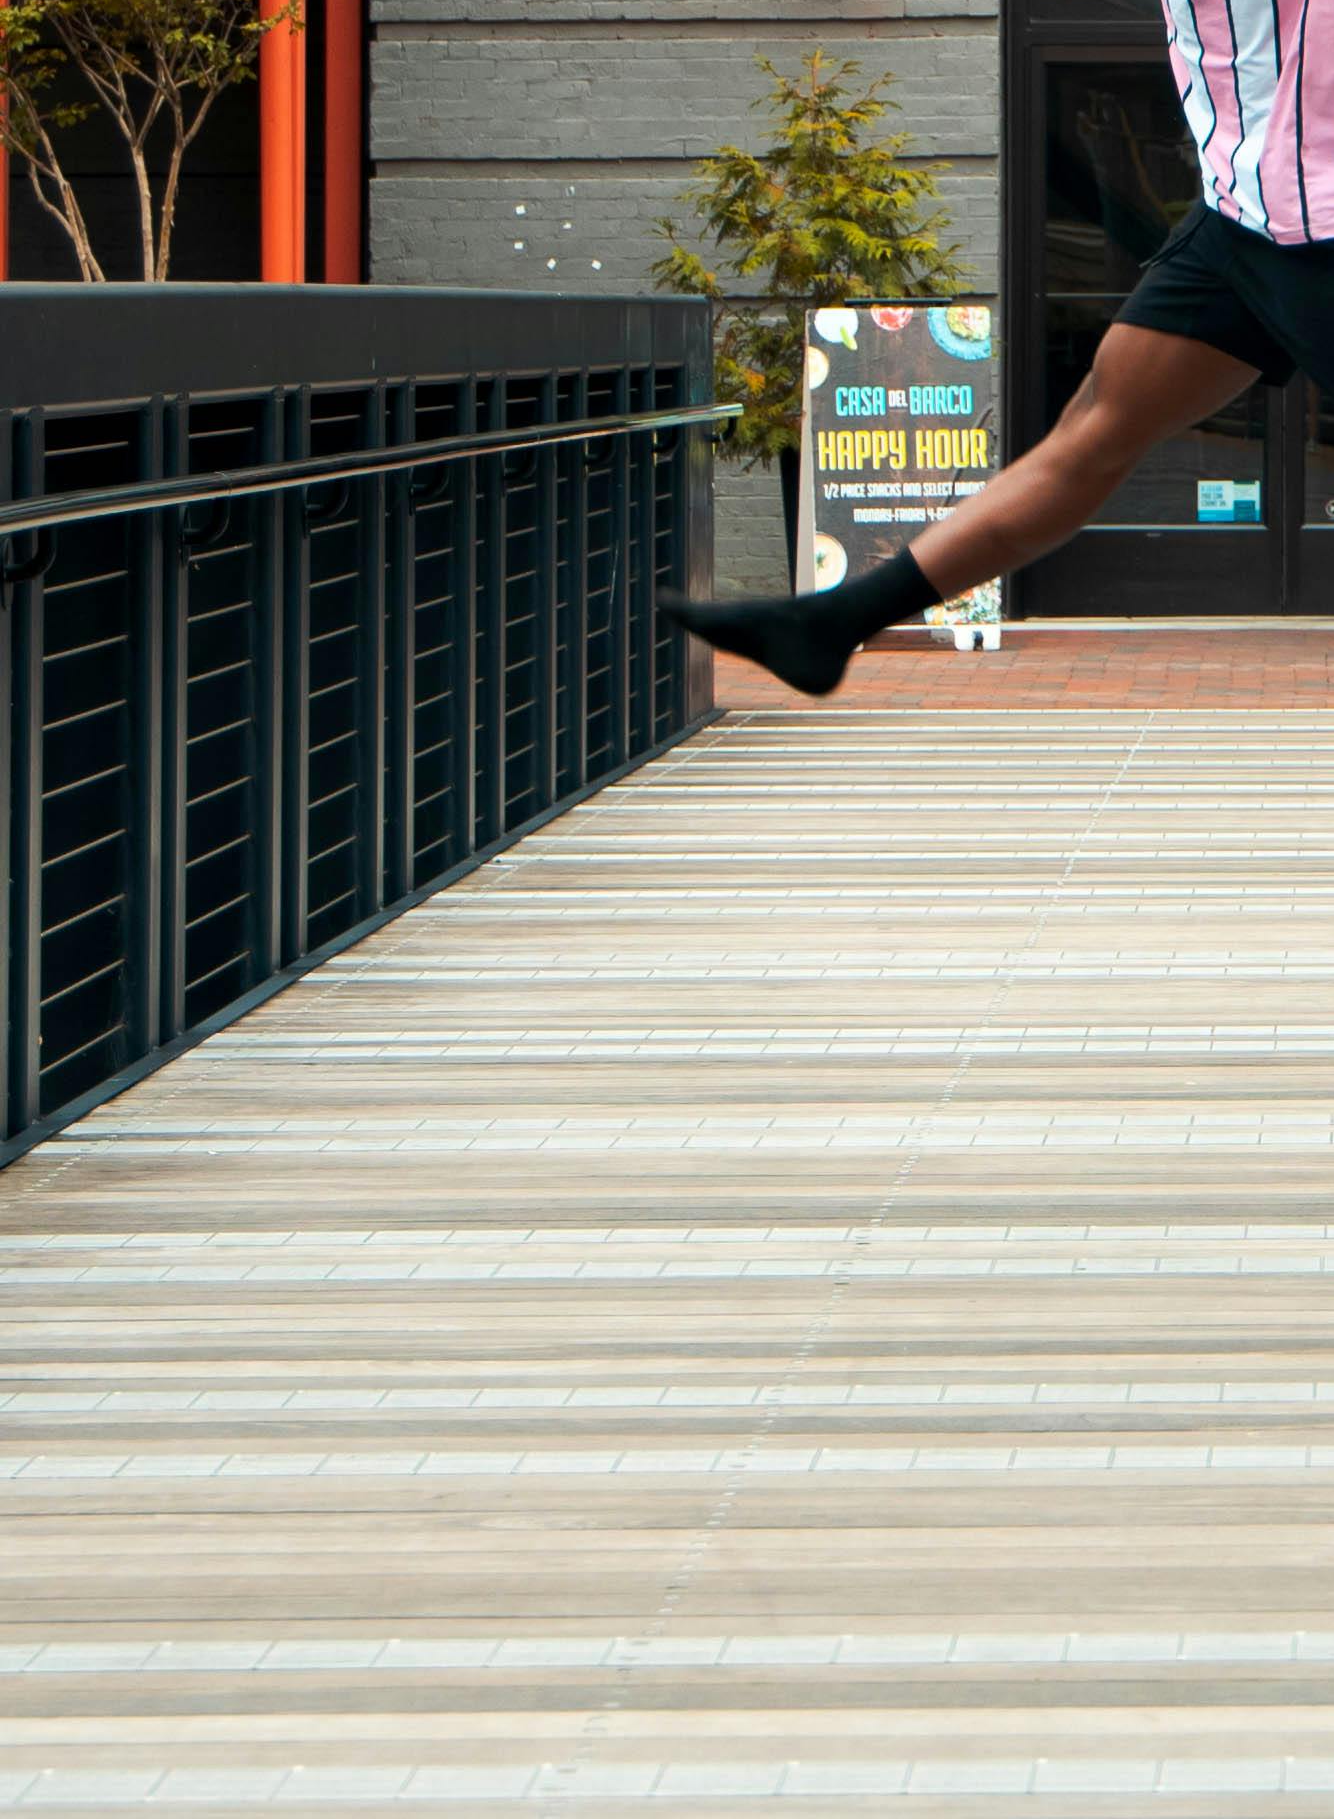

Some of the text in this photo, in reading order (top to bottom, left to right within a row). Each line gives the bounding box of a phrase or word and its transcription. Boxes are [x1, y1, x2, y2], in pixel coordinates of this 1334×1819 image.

[835, 385, 973, 416] CASA DEL BARCO
[818, 428, 988, 470] HAPPY HOUR
[824, 482, 839, 500] 1/2
[841, 483, 866, 498] PRICE
[867, 482, 902, 497] SNACKS
[922, 482, 953, 497] SELECT
